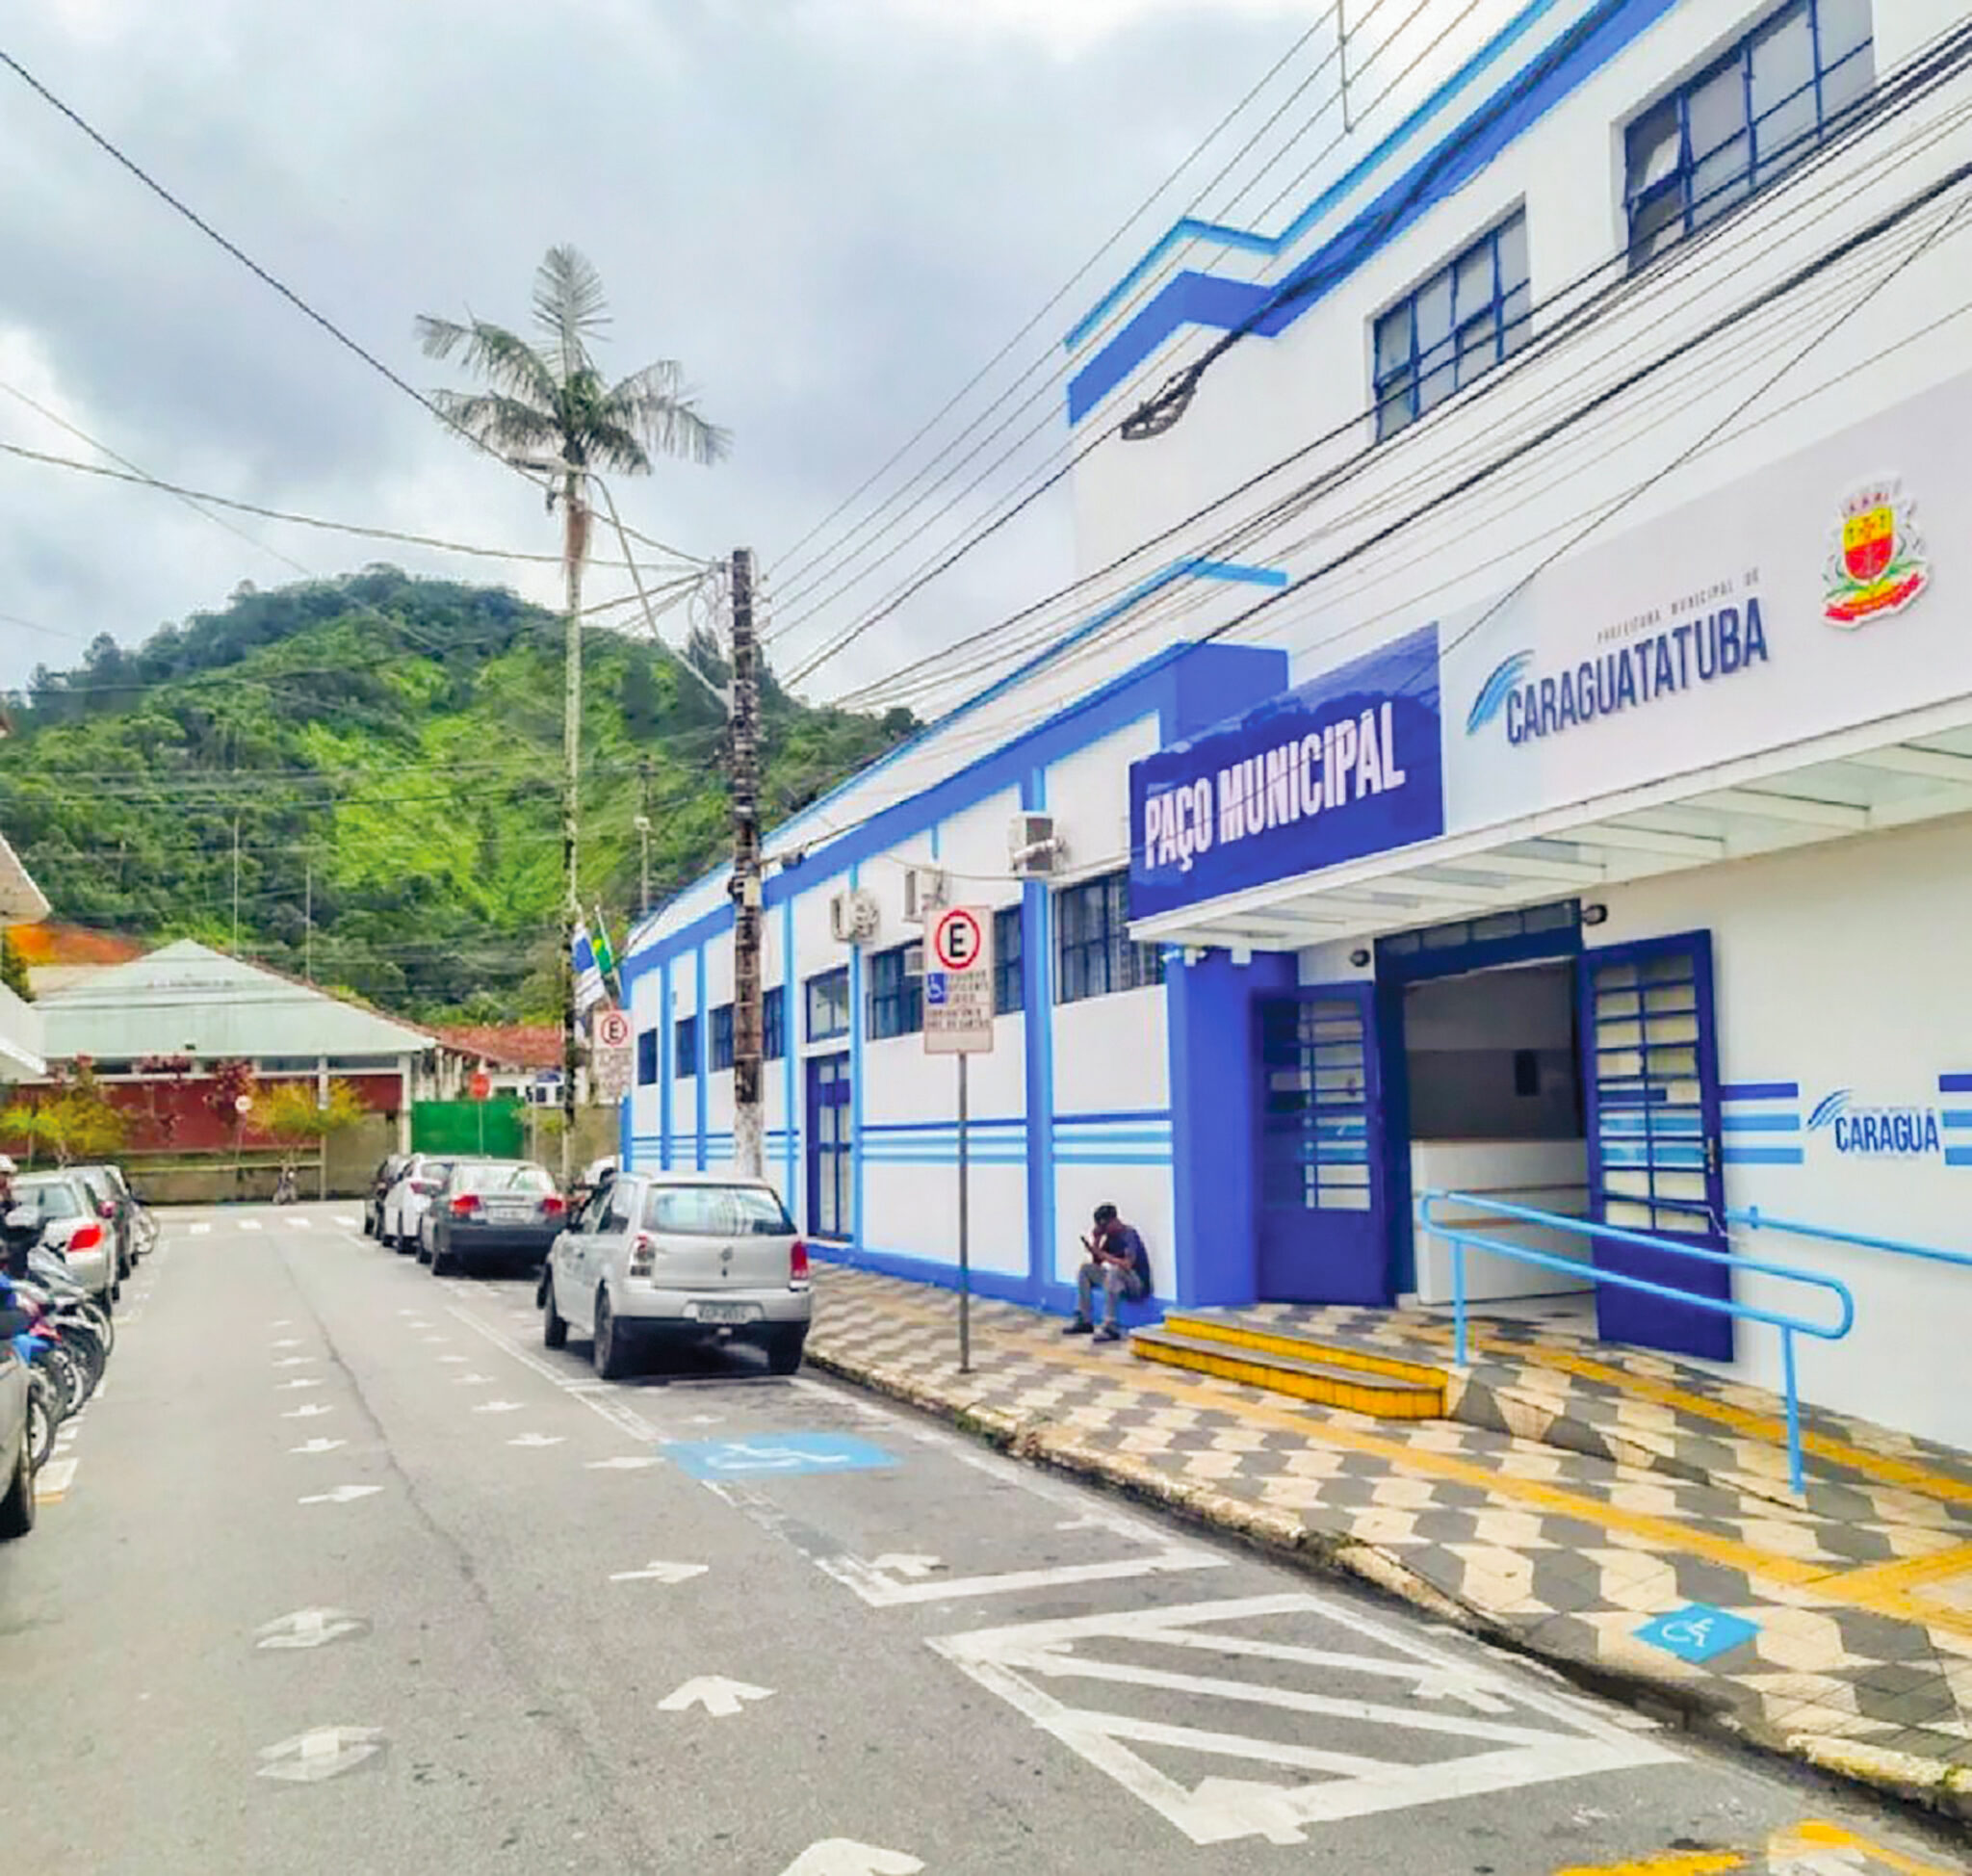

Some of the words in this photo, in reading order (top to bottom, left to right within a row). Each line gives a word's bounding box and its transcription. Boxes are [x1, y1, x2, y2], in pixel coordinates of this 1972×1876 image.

[1506, 597, 1769, 746] CARAGUATATUBA
[1144, 777, 1213, 872] PAÇO
[1217, 701, 1406, 845] MUNICIPAL
[948, 923, 967, 957] E
[609, 1021, 619, 1040] E
